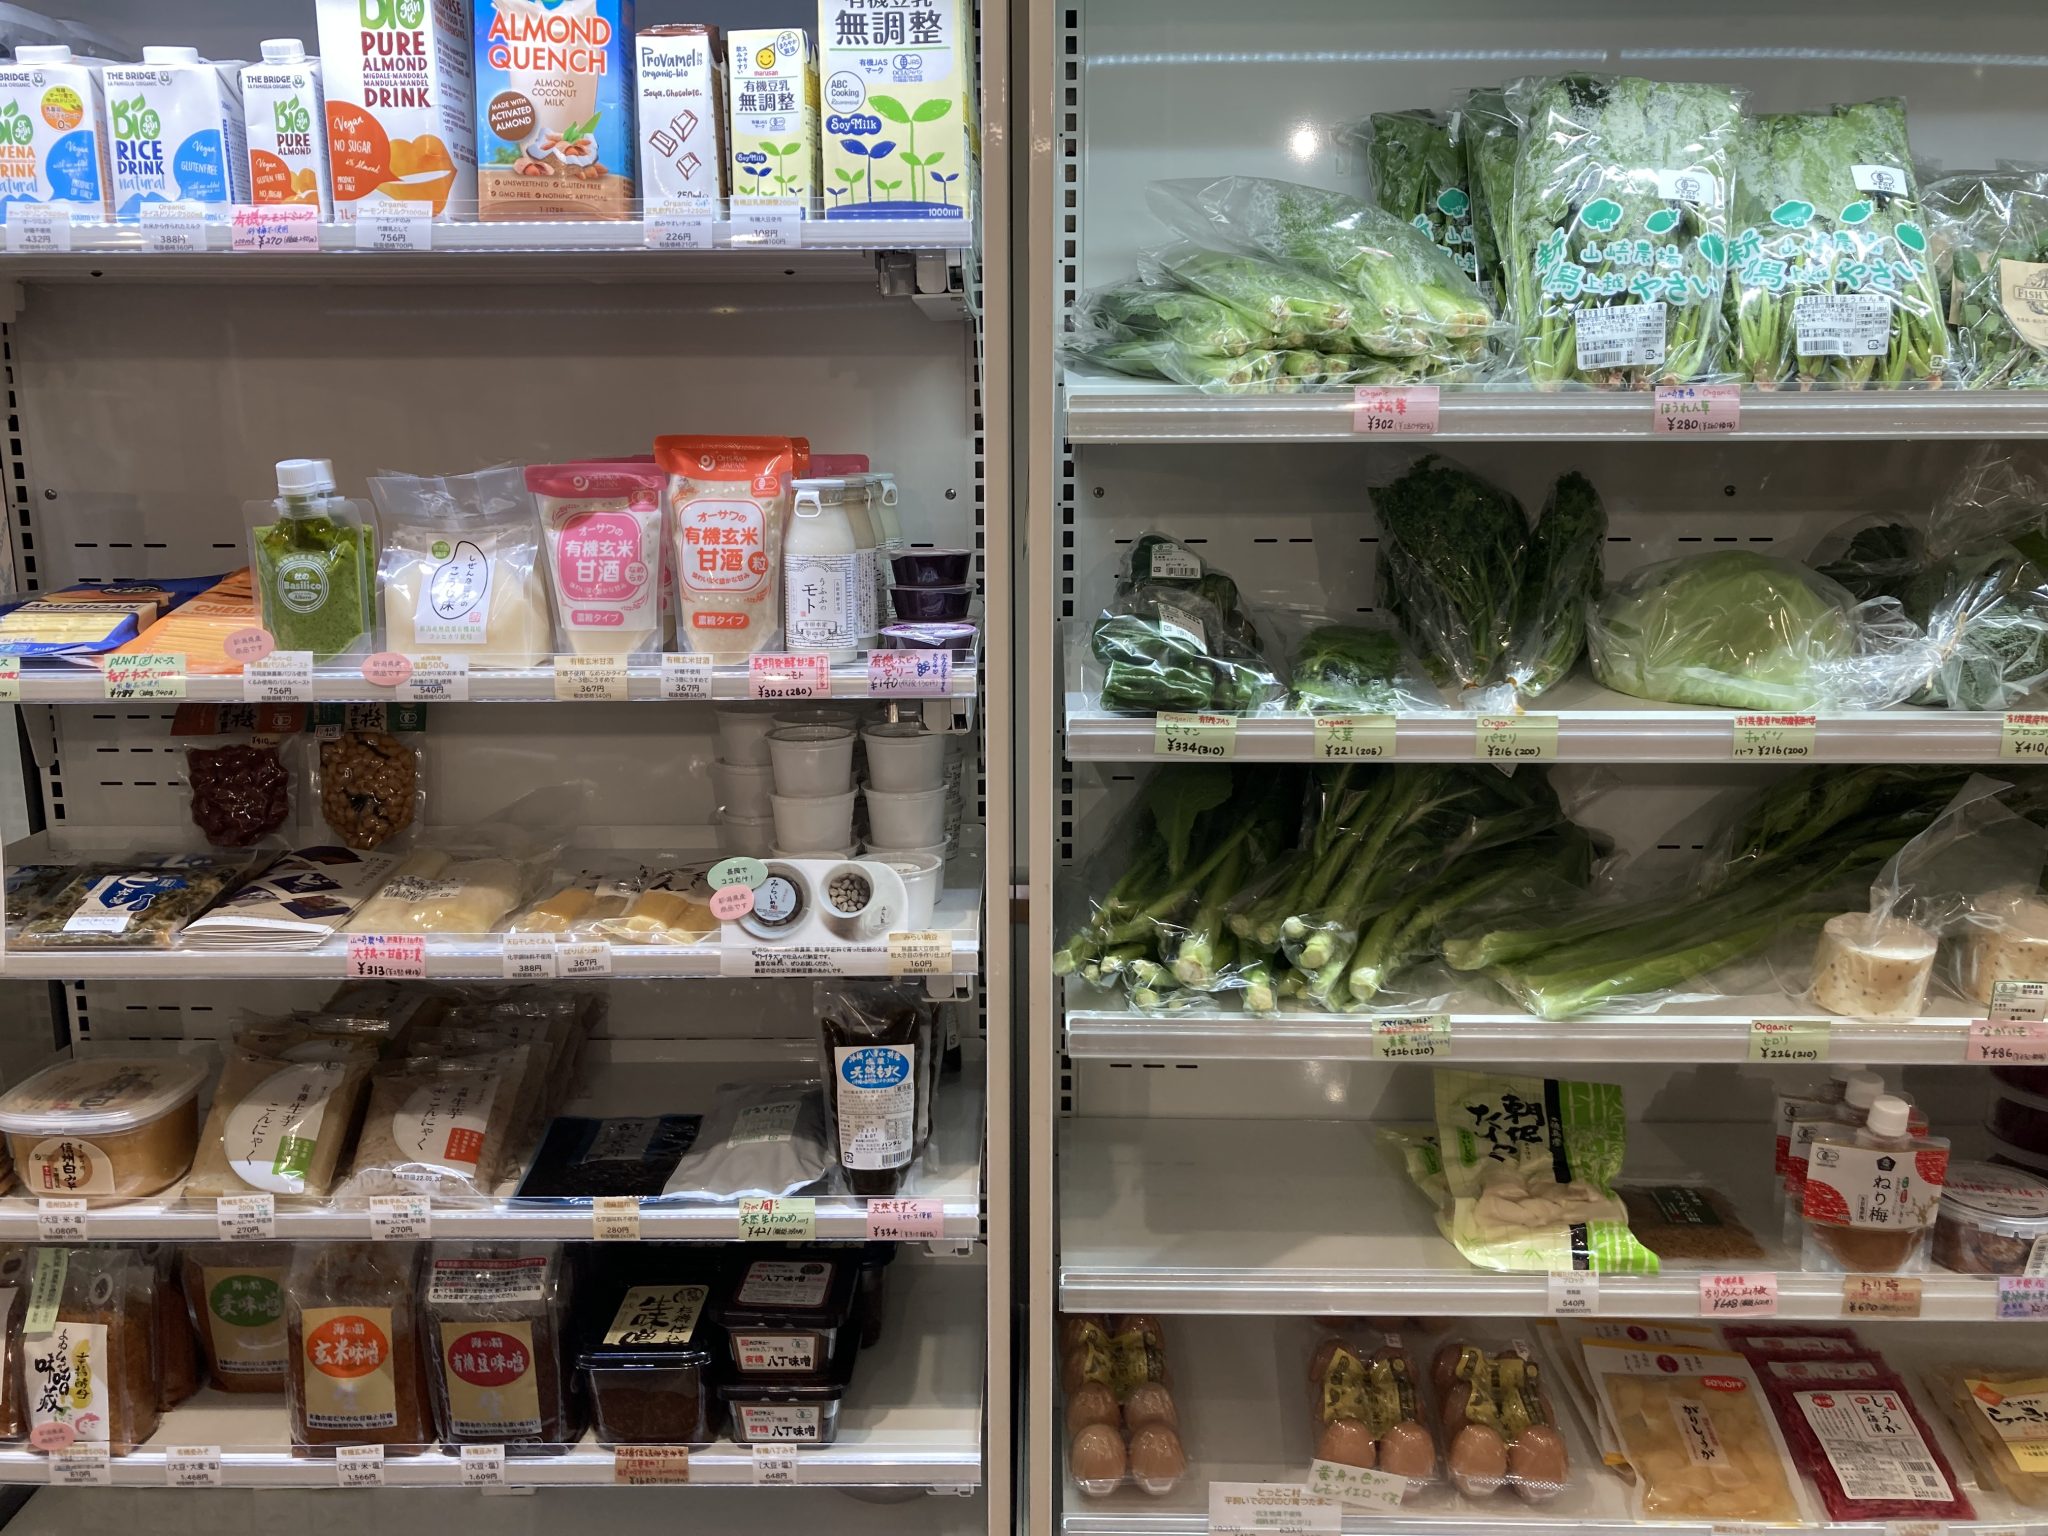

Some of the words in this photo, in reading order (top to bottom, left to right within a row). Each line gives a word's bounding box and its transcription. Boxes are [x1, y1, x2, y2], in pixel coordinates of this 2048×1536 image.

[489, 14, 611, 46] ALMOND
[835, 10, 943, 46] 無調整
[361, 31, 427, 56] PURE
[489, 47, 606, 75] QUENCH
[641, 46, 696, 68] Provamel
[858, 58, 888, 68] 有機JAS
[362, 57, 428, 72] ALMOND
[865, 66, 884, 75] マーク
[107, 72, 124, 80] THE
[125, 72, 156, 80] BRIDGE
[247, 76, 262, 84] THE
[263, 76, 291, 85] BRIDGE
[534, 79, 575, 88] ALMOND
[743, 80, 790, 93] 有機豆乳
[831, 80, 848, 89] ABC
[364, 87, 431, 108] DRINK
[531, 89, 577, 99] COCONUT
[831, 88, 860, 98] Cooking
[491, 100, 510, 110] MADE
[510, 98, 527, 107] WITH
[544, 97, 565, 107] MILK
[738, 92, 795, 112] 無調整
[491, 106, 532, 122] ACTIVATED
[333, 116, 364, 133] Vegan
[496, 116, 532, 131] ALMOND
[277, 133, 310, 148] PURE
[66, 140, 89, 154] Vegan
[115, 140, 163, 161] RICE
[192, 140, 216, 154] Vegan
[278, 147, 311, 156] ALMOND
[334, 140, 345, 152] NO
[348, 142, 372, 155] SUGAR
[118, 160, 165, 175] DRINK
[256, 158, 277, 170] Vegan
[119, 176, 165, 194] natural
[502, 180, 549, 188] UNSWEETENED
[516, 191, 531, 199] FREE
[543, 193, 574, 201] NOTHING
[378, 200, 407, 209] Organic
[663, 199, 693, 208] Organic
[928, 208, 959, 218] 1000ml
[25, 235, 51, 243] 432円
[160, 235, 186, 244] 388円
[258, 235, 283, 249] ¥270
[380, 233, 406, 242] 756円
[665, 232, 692, 241] 226円
[1581, 239, 1683, 269] 山崎農場
[1835, 257, 1928, 290] やさい
[1584, 273, 1627, 292] 上越
[1630, 271, 1713, 305] やさい
[2017, 287, 2042, 300] FISH
[1359, 390, 1390, 398] Organic
[1702, 388, 1733, 397] Organic
[1661, 400, 1711, 415] ほうれん草
[1367, 418, 1394, 430] ¥302
[1667, 416, 1699, 431] ¥280
[697, 510, 747, 523] オーサワの
[578, 523, 624, 537] オーサワの
[684, 526, 758, 546] 有機玄米
[565, 539, 634, 558] 有機玄米
[696, 548, 743, 572] 甘酒
[752, 556, 766, 571] 粒
[576, 559, 620, 583] 甘酒
[628, 566, 645, 574] なめ
[629, 574, 645, 582] らか
[284, 581, 322, 590] Basilico
[802, 583, 818, 615] モト
[25, 602, 139, 611] AMERICAN
[570, 657, 614, 665] 有機玄米甘酒
[666, 656, 710, 664] 有機玄米甘酒
[882, 665, 913, 676] ゼリー
[580, 685, 605, 693] 367円
[675, 684, 700, 692] 367円
[870, 677, 898, 690] ¥140
[267, 687, 292, 695] 756円
[419, 686, 444, 694] 540円
[1164, 715, 1193, 723] Organic
[1318, 718, 1353, 728] Organic
[1482, 718, 1516, 730] Organic
[1165, 724, 1201, 737] ピーマン
[1327, 728, 1354, 742] 大葉
[1484, 732, 1517, 744] パセリ
[357, 961, 385, 976] ¥313
[518, 964, 542, 972] 388円
[573, 958, 598, 967] 367円
[909, 959, 932, 968] 160円
[1754, 1022, 1793, 1033] Organic
[1761, 1036, 1789, 1046] セロリ
[1981, 1045, 2013, 1059] ¥486
[849, 1065, 901, 1079] 天然もずく
[246, 1102, 279, 1166] こんにゃく
[1869, 1174, 1892, 1223] ねり梅
[873, 1201, 917, 1214] 天然もずく
[237, 1226, 260, 1234] 270円
[606, 1226, 630, 1234] 280円
[748, 1226, 772, 1236] ¥421
[873, 1226, 898, 1237] ¥334
[452, 1350, 525, 1374] 有機豆味噌
[745, 1355, 764, 1364] 有機
[767, 1354, 811, 1368] 八丁味噌
[1705, 1378, 1743, 1388] 50%OFF
[749, 1425, 769, 1434] 有機
[772, 1425, 816, 1437] 八丁味噌
